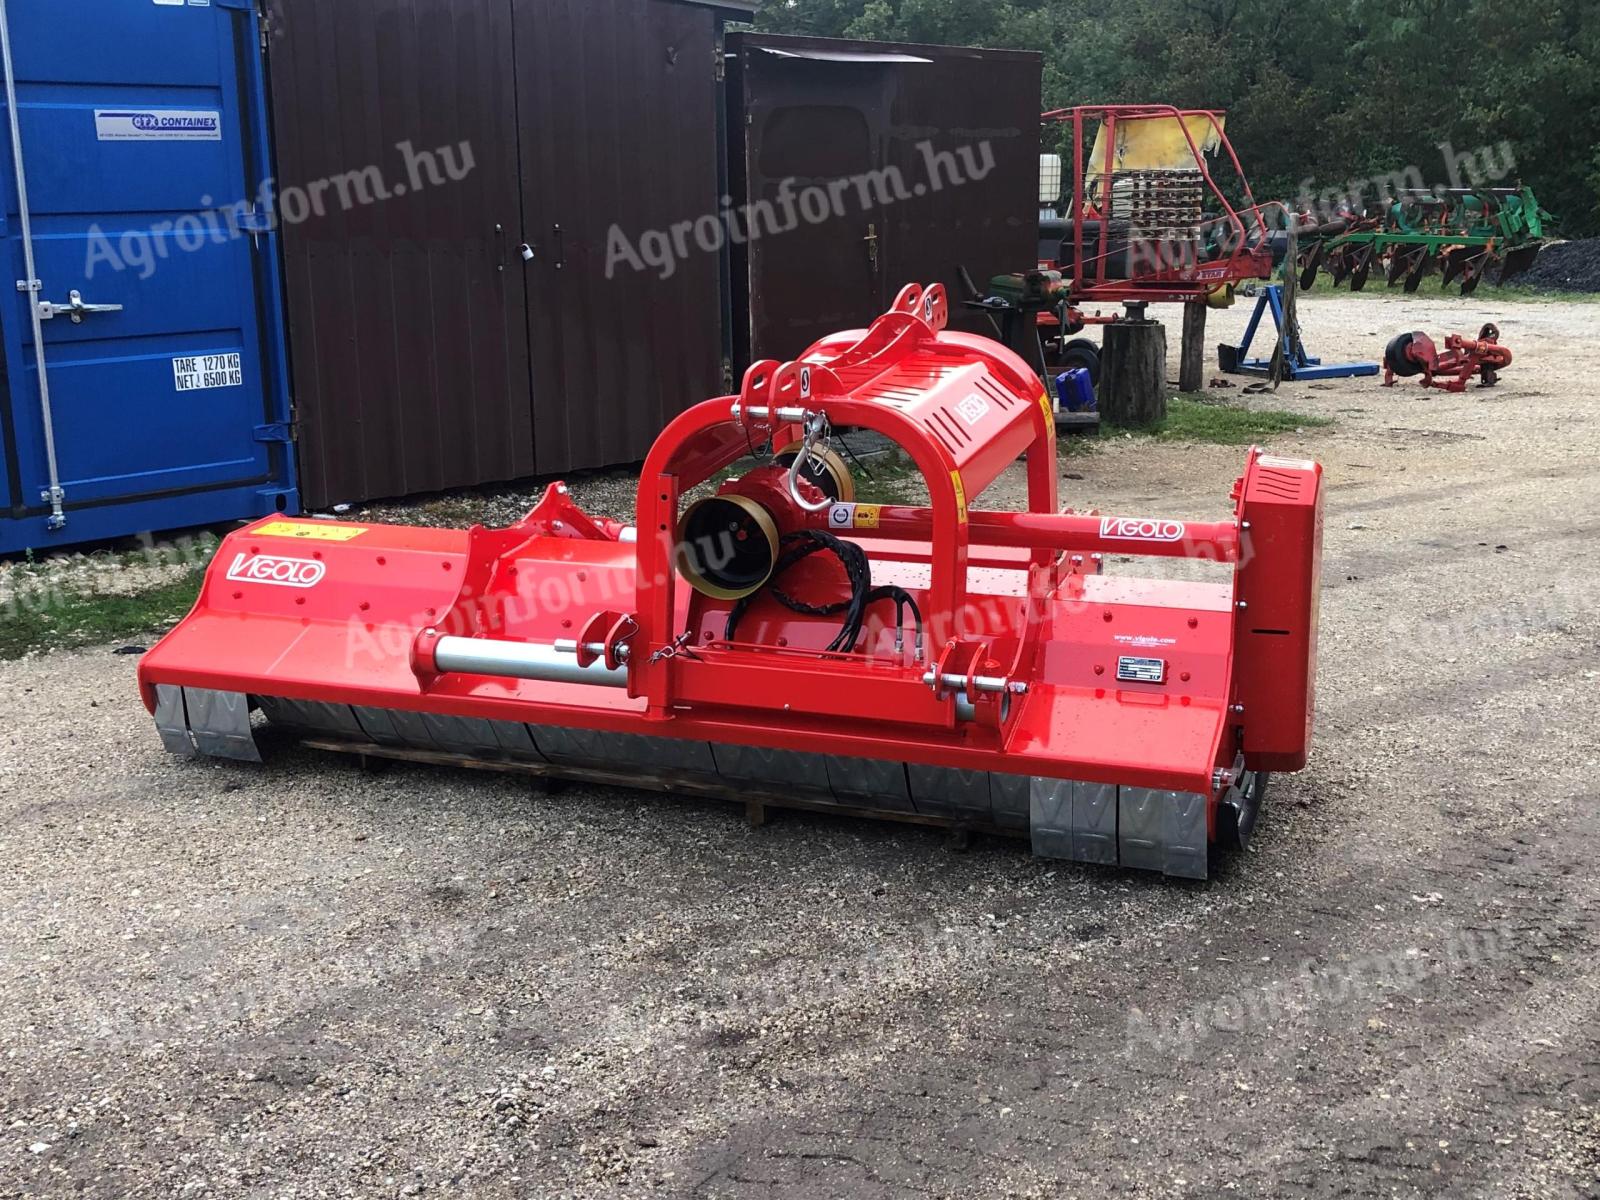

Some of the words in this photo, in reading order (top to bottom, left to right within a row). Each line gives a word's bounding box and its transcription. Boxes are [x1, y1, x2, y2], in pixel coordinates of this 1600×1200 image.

[161, 117, 217, 128] CONTAINEX
[174, 358, 197, 373] TARE
[203, 355, 226, 371] 1270
[227, 354, 240, 369] KG
[203, 371, 227, 386] 6500
[229, 370, 241, 384] KG
[1100, 517, 1185, 542] VIGOLO
[227, 553, 326, 588] VIGOLO
